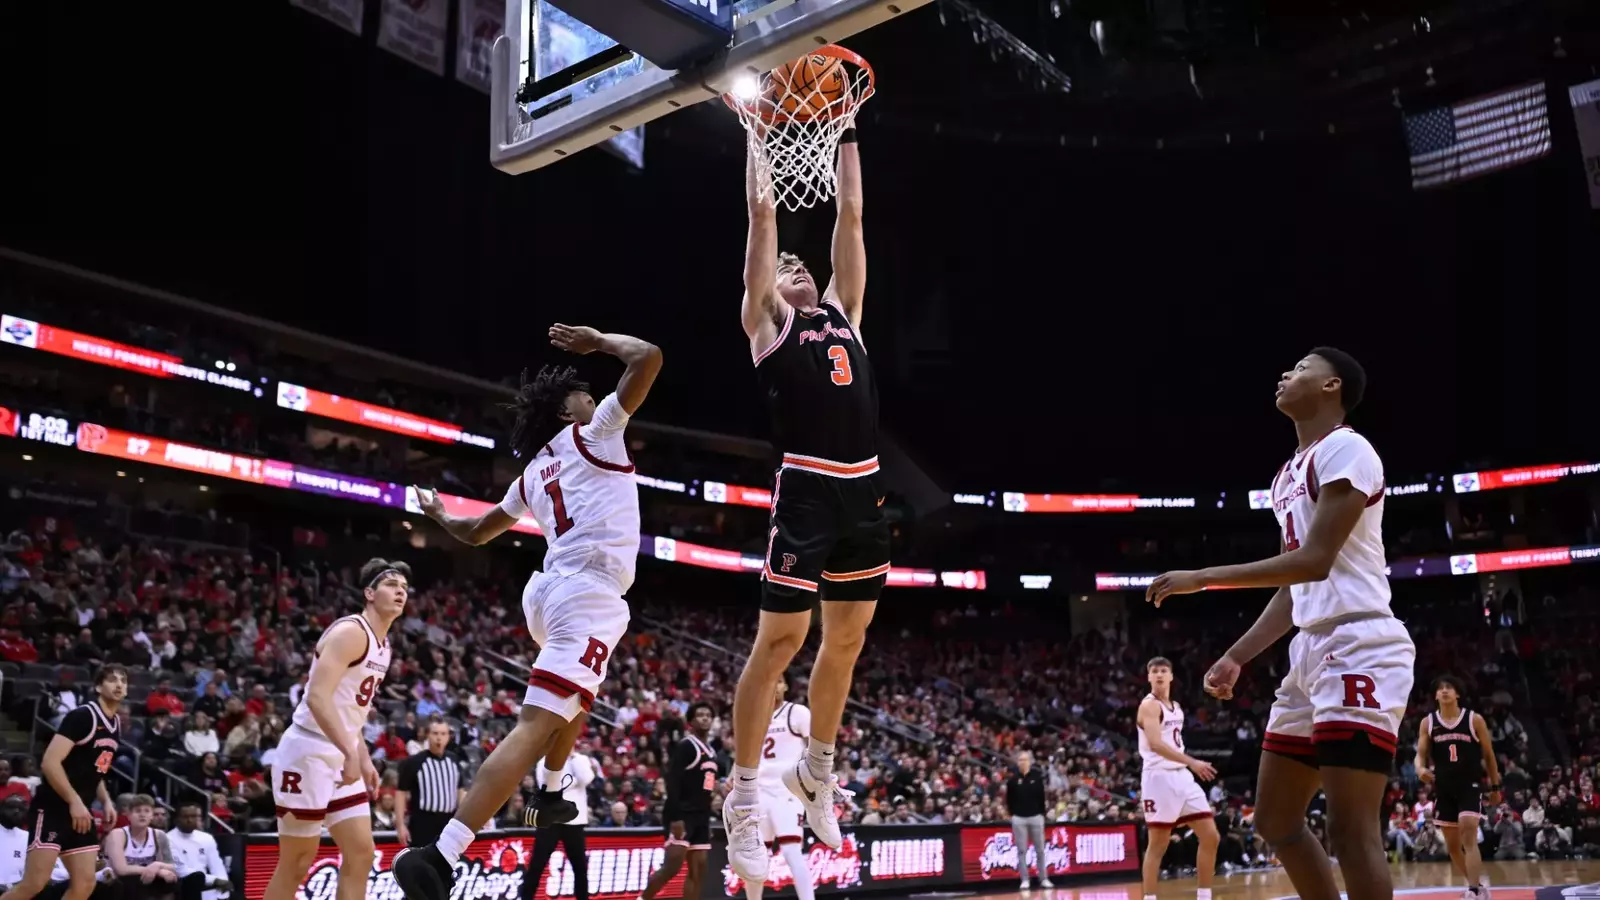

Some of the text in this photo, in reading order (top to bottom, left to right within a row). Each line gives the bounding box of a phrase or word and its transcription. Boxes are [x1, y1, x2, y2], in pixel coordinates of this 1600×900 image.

[827, 345, 852, 386] 3
[540, 460, 562, 482] DAVIS
[544, 478, 575, 538] 1
[780, 552, 797, 572] P
[578, 636, 609, 677] R
[1341, 673, 1381, 709] R
[1448, 743, 1459, 762] 1
[280, 770, 302, 794] R
[1143, 799, 1158, 813] R
[13, 850, 22, 859] R
